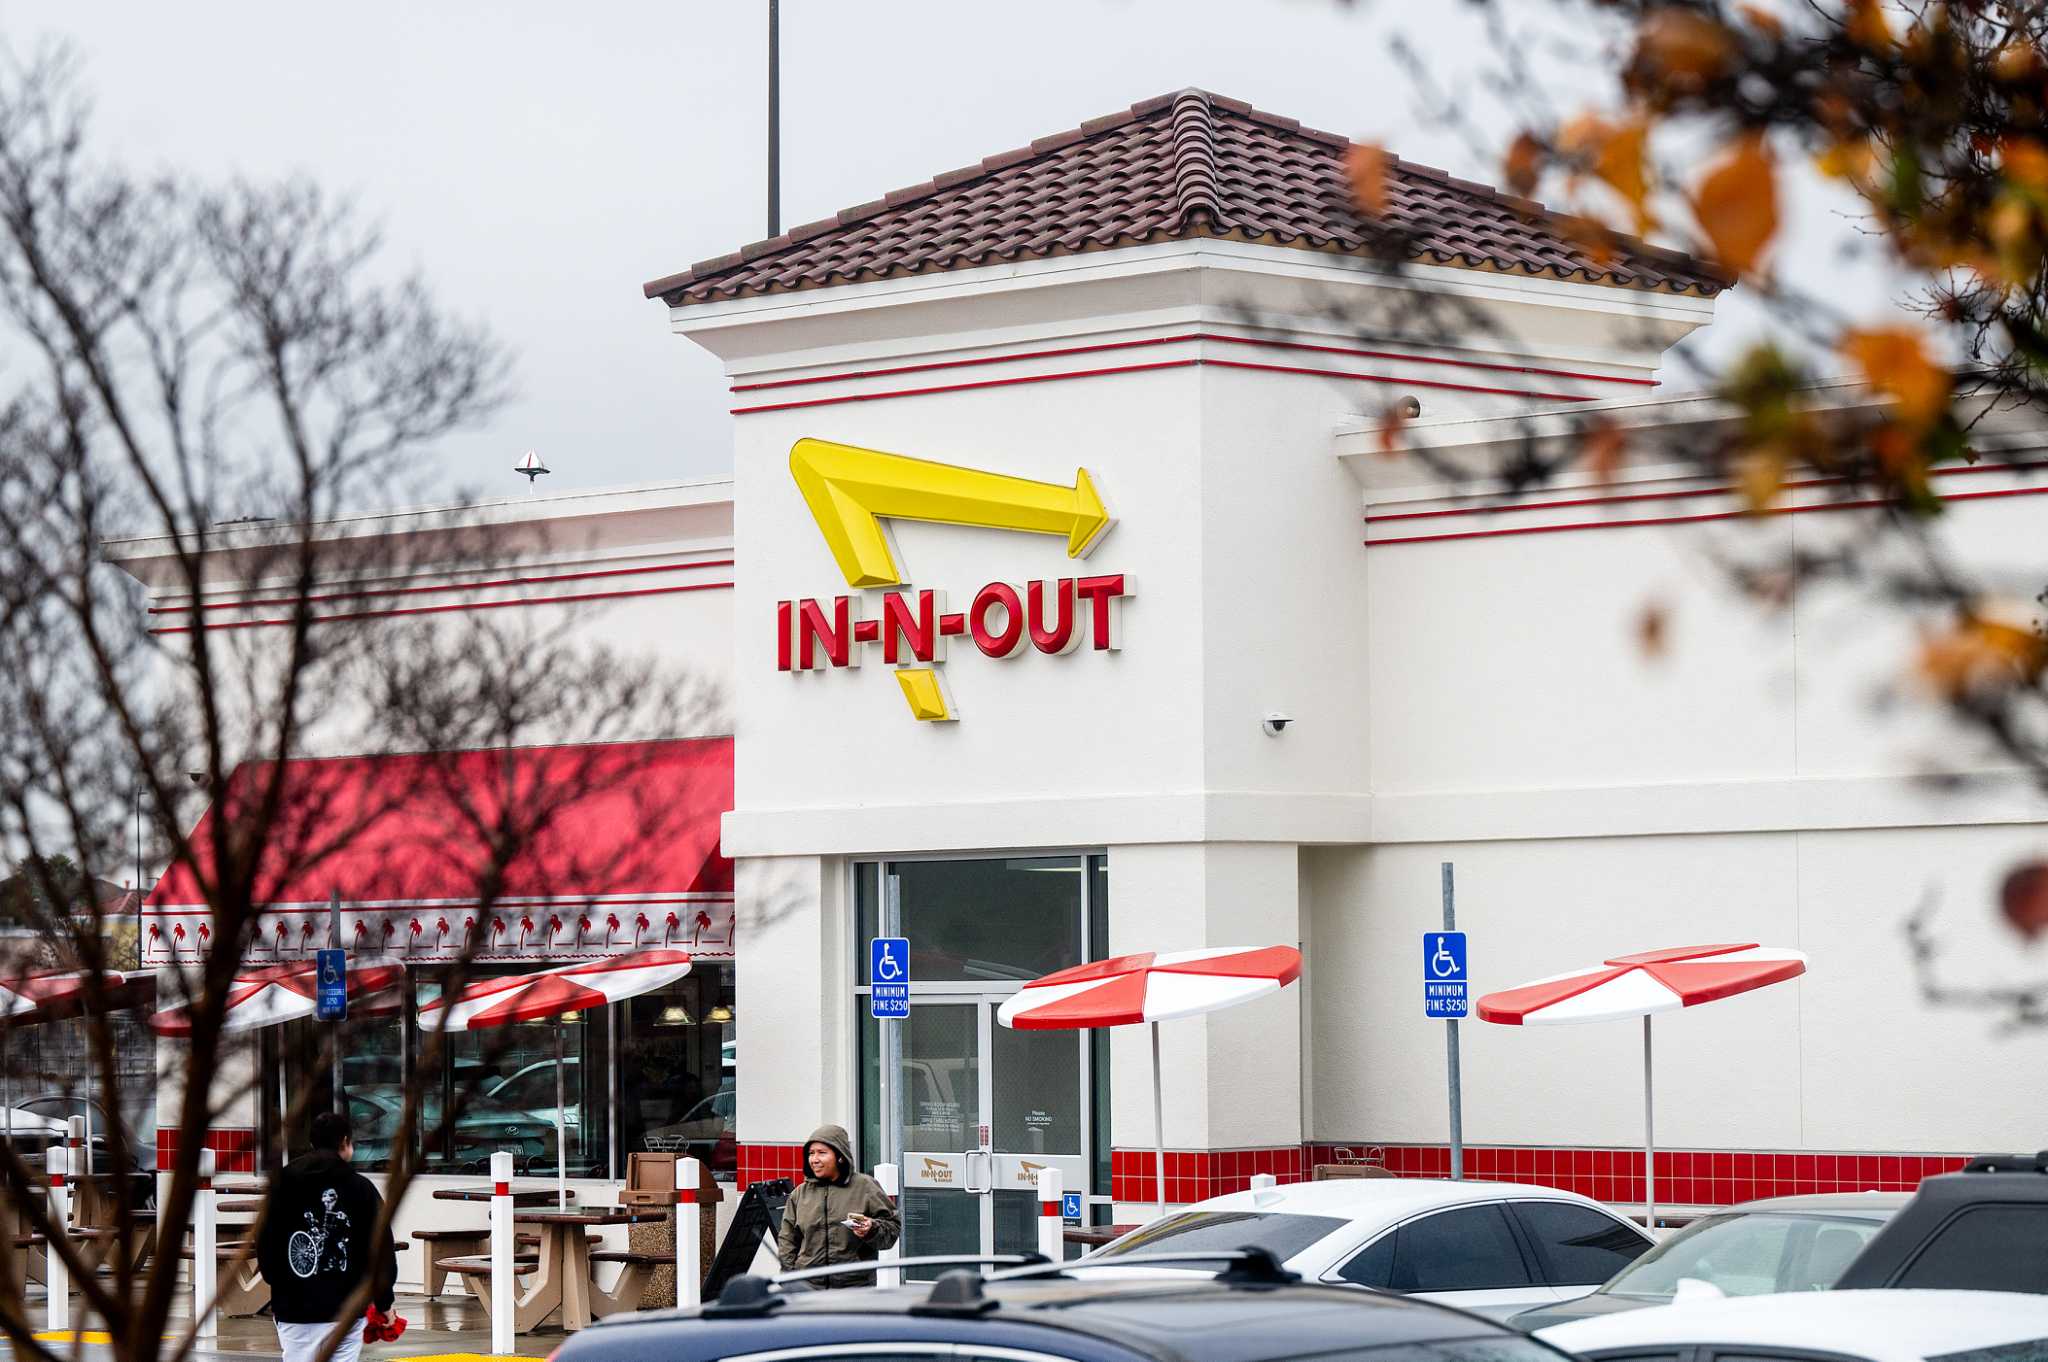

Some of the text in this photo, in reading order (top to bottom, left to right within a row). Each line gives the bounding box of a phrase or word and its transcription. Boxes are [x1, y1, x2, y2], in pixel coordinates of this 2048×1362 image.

[778, 574, 1133, 672] IN-N-OUT
[875, 986, 905, 997] MINIMUM
[1429, 985, 1464, 996] MINIMUM
[873, 999, 907, 1012] FINE $250
[1426, 998, 1466, 1012] FINE $250
